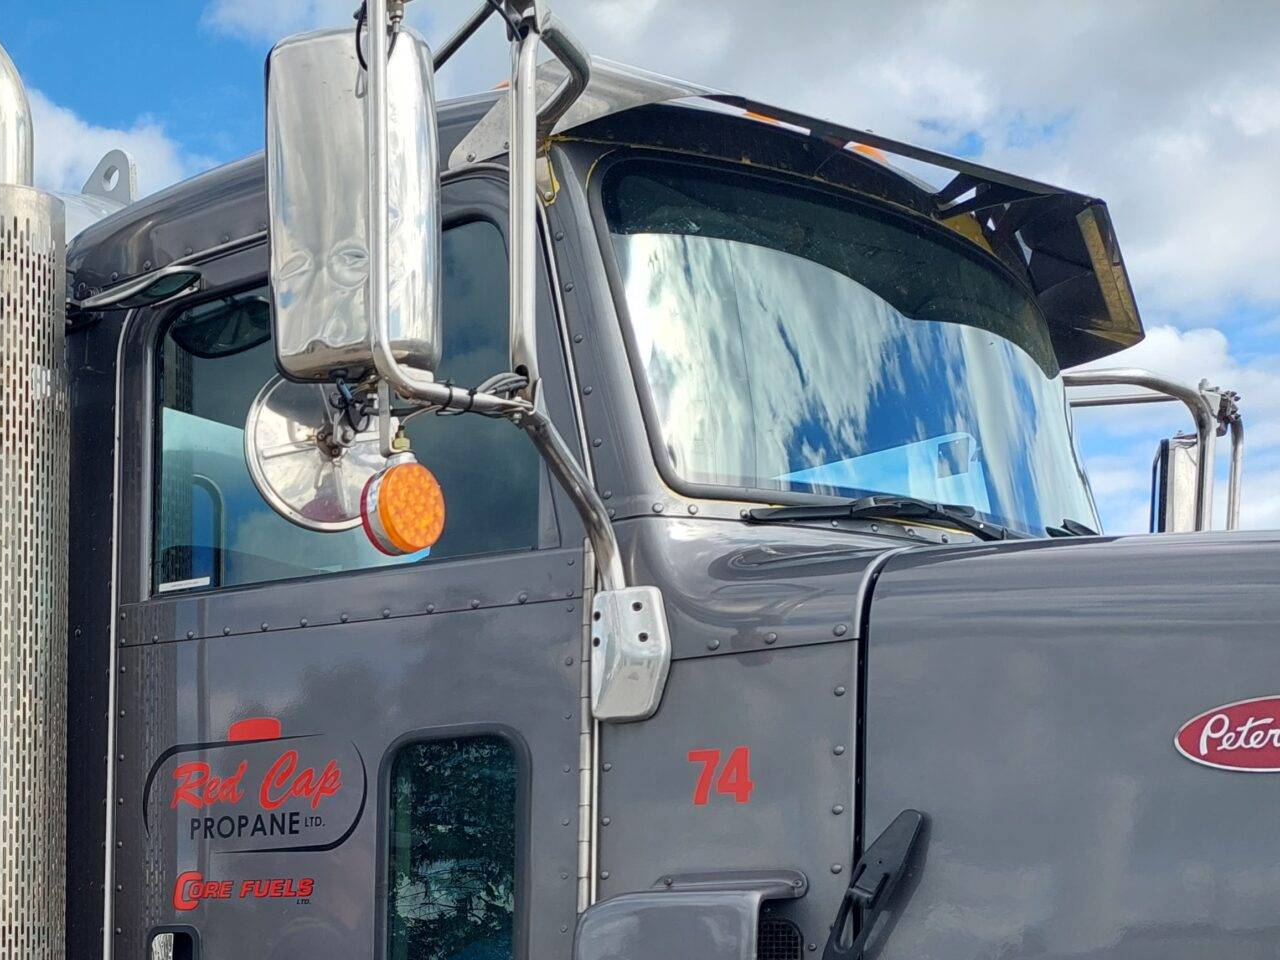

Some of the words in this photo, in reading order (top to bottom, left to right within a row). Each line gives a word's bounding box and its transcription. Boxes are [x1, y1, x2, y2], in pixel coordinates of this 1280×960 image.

[170, 760, 249, 809] Red
[259, 750, 342, 810] Cap
[687, 746, 754, 806] 74
[190, 812, 300, 840] PROPANE
[304, 816, 326, 828] LTD.
[173, 871, 235, 911] CORE
[239, 878, 315, 899] FUELS
